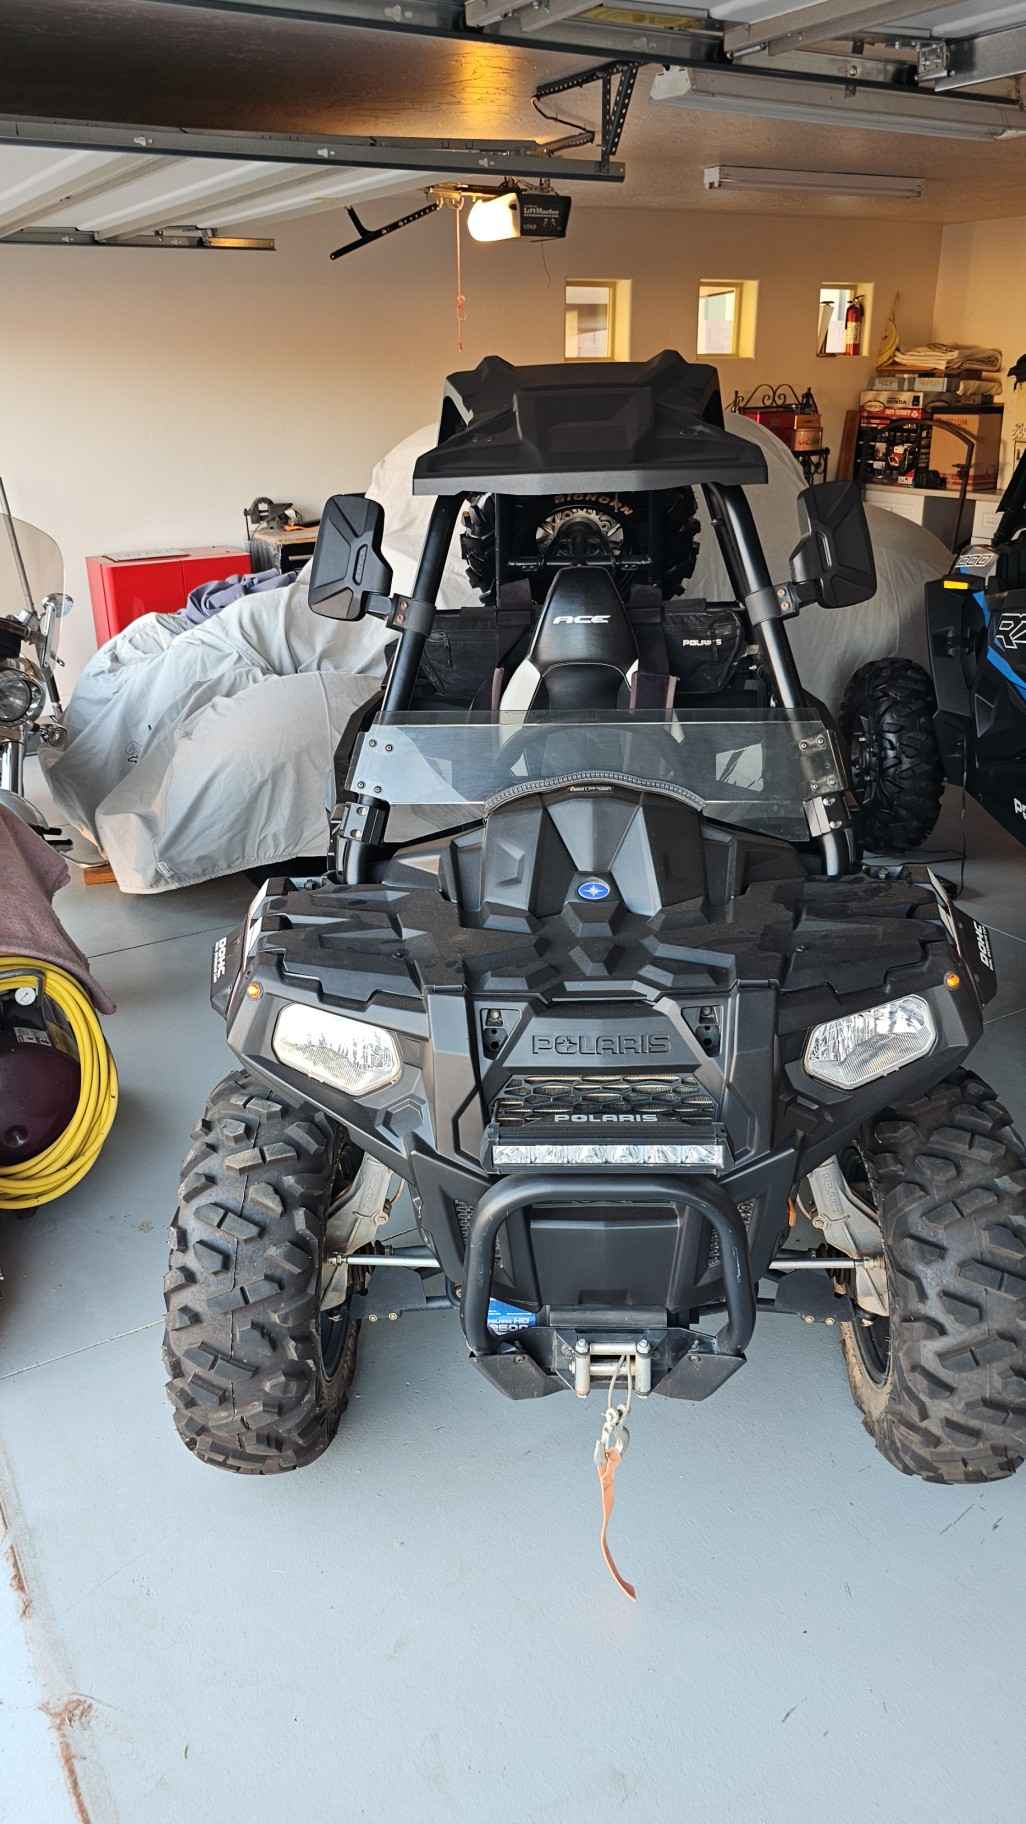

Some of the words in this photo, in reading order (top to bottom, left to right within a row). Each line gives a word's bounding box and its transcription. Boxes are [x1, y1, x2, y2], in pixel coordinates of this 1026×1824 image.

[552, 615, 611, 625] ACE
[532, 1034, 670, 1055] POLARIS
[554, 1113, 658, 1123] POLARIS
